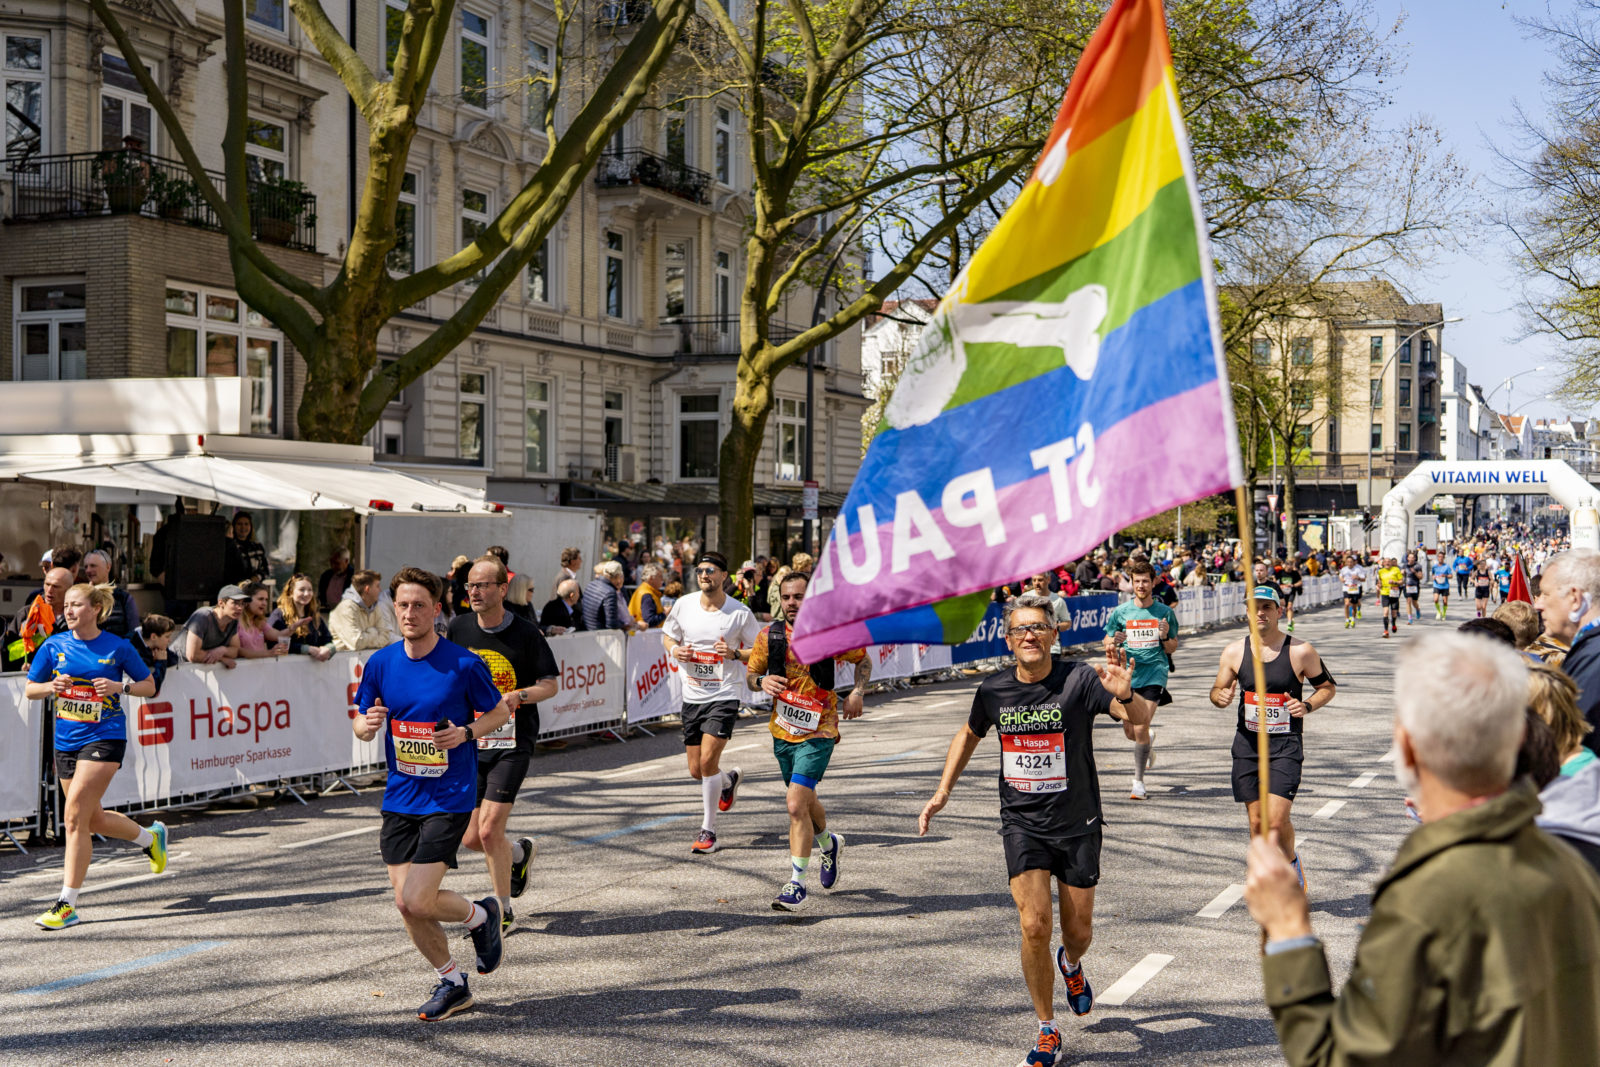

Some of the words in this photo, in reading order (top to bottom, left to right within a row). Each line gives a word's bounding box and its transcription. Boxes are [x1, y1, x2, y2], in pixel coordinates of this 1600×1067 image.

[1431, 471, 1500, 484] VITAMIN
[1505, 470, 1548, 483] WELL
[1080, 609, 1098, 628] asics
[694, 664, 714, 675] 7539
[62, 700, 92, 714] 20148
[1030, 702, 1061, 711] AMERICA
[1255, 707, 1279, 719] 535
[189, 697, 291, 743] Haspa
[783, 705, 812, 723] 10420
[1000, 709, 1062, 725] CHICAGO
[409, 726, 432, 735] Haspa
[1000, 723, 1048, 732] MARATHON
[399, 740, 435, 755] 22006
[1023, 739, 1050, 748] Haspa
[191, 753, 244, 770] Hamburger
[246, 746, 292, 764] Sparkasse
[1015, 755, 1052, 769] 4324
